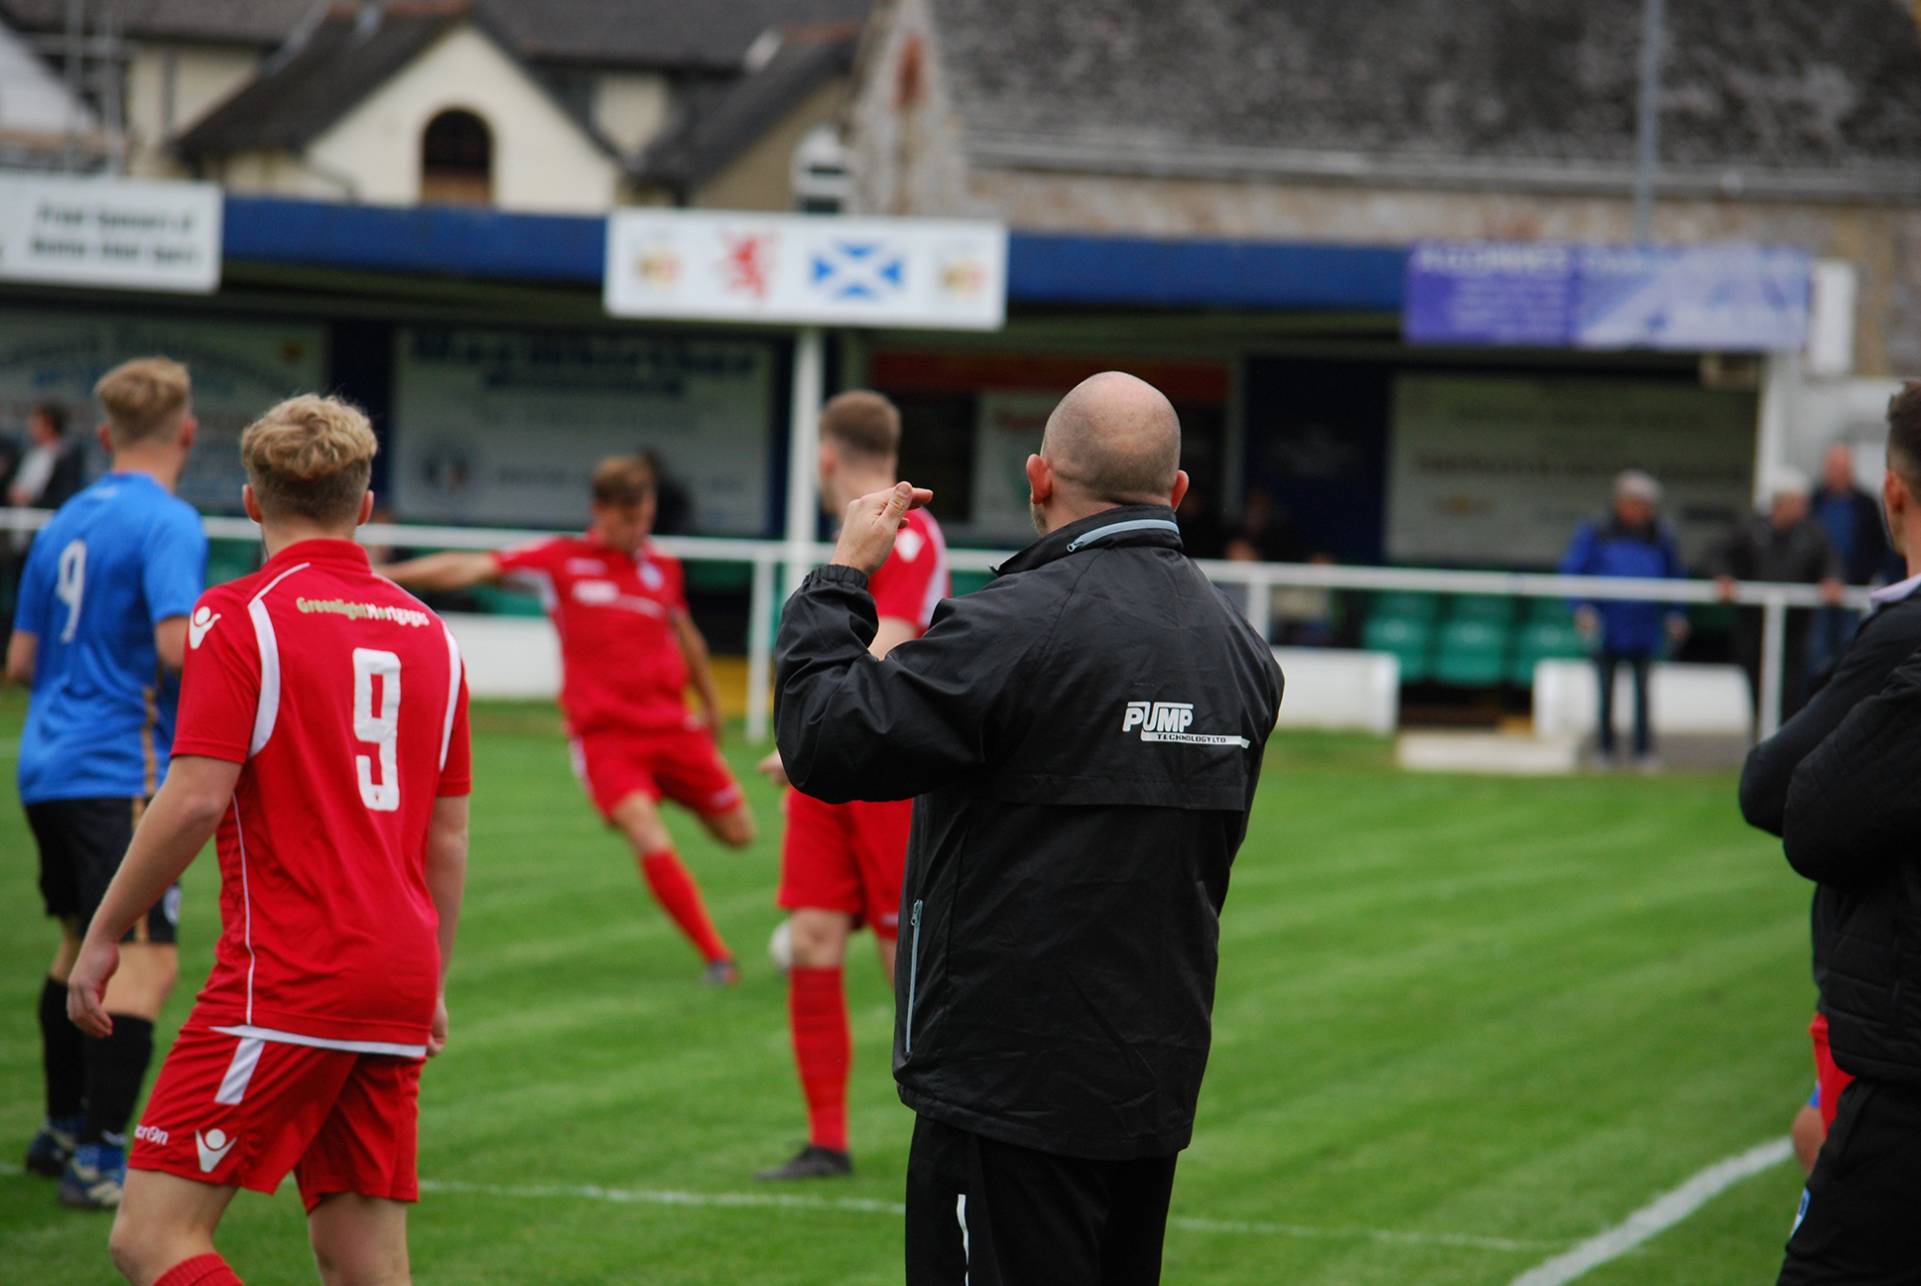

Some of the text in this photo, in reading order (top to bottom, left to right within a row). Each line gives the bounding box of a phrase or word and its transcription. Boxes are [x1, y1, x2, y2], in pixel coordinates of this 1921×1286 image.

[57, 539, 87, 643] 9
[352, 647, 401, 811] 9
[1122, 701, 1194, 733] PUMP
